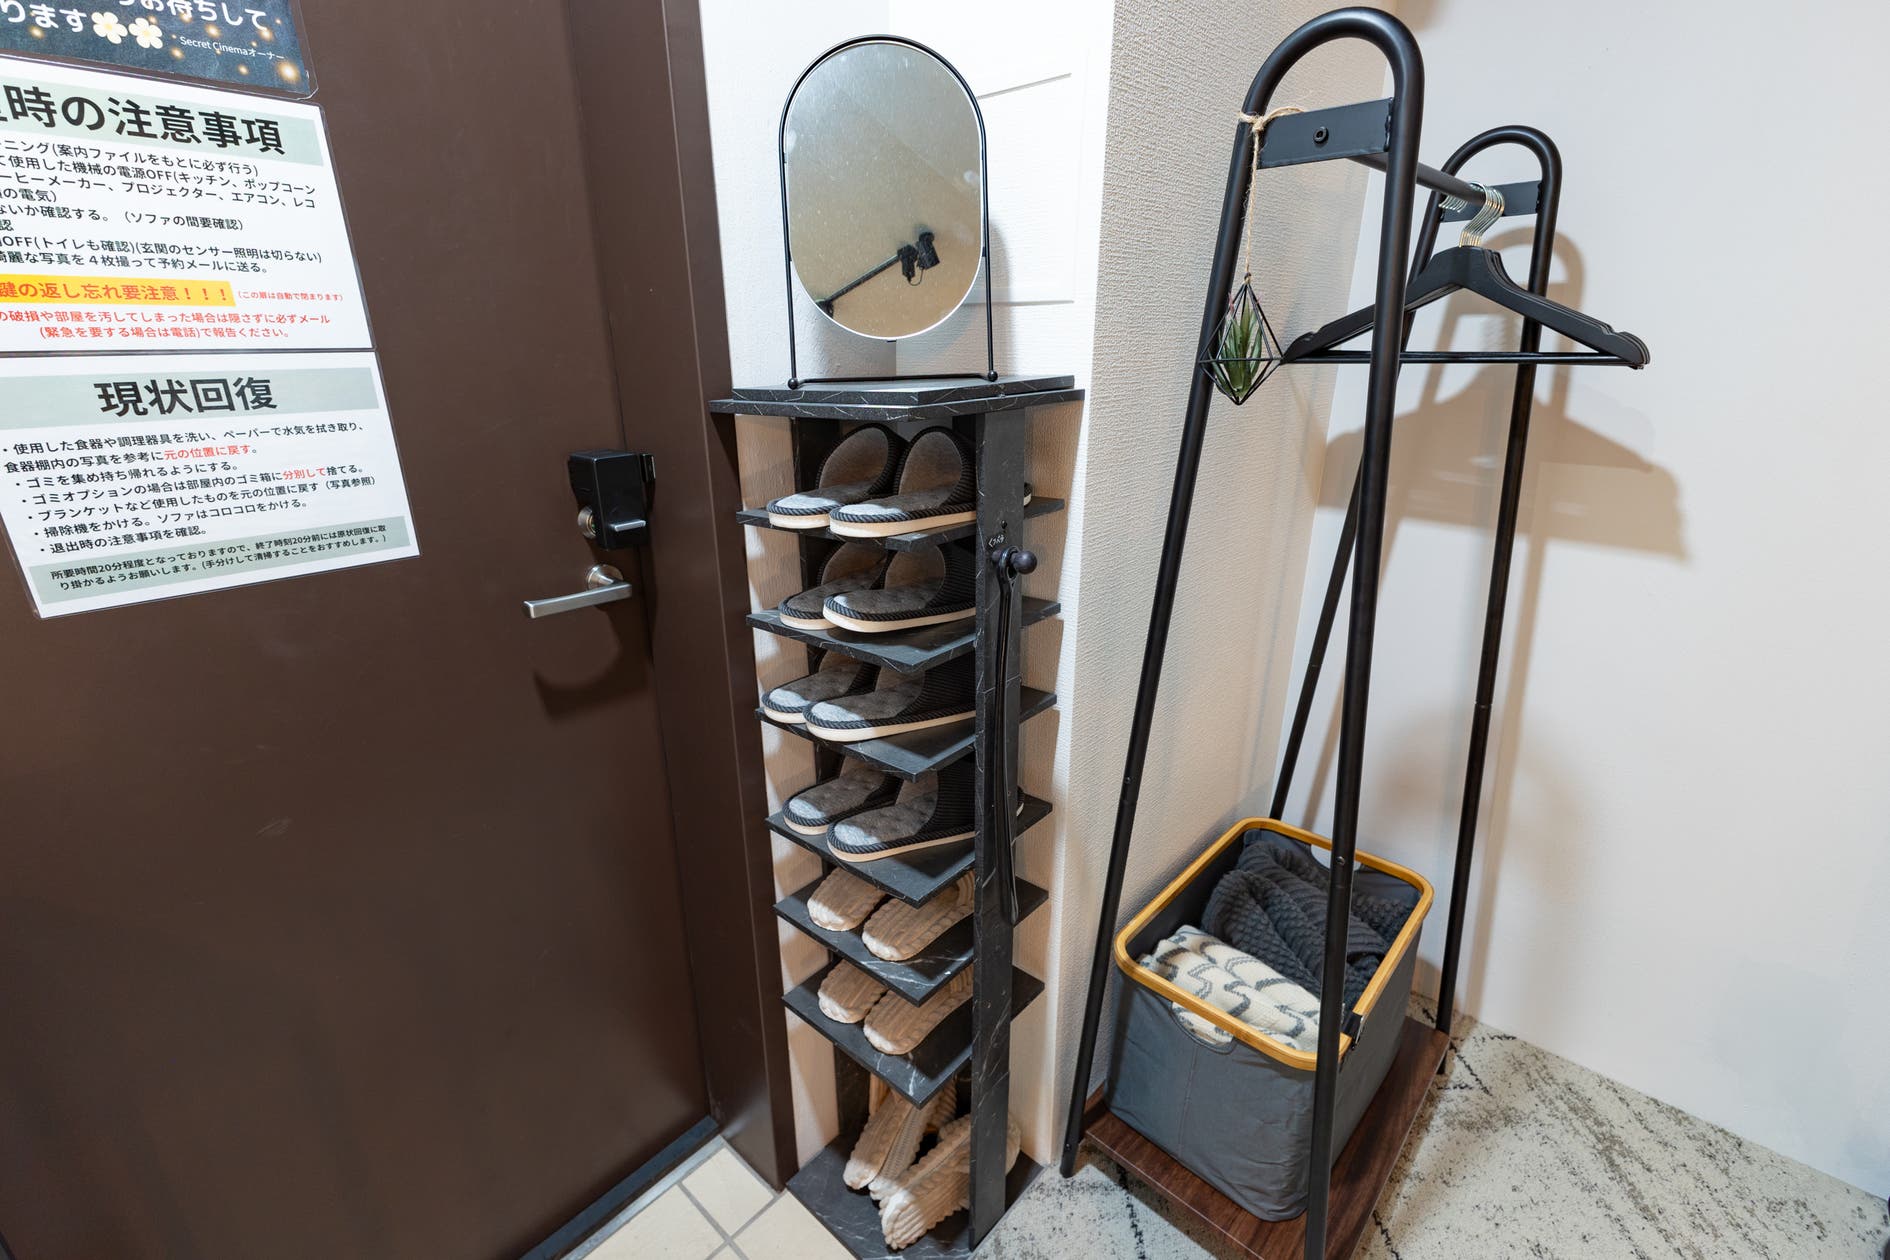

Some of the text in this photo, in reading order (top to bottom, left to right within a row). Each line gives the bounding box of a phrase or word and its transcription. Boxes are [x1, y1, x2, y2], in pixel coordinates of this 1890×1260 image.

[179, 36, 213, 50] Secret
[0, 85, 285, 155] 時の注意事項
[0, 140, 259, 177] ニング(案内ファイルをもとに必ず行う)
[0, 188, 56, 203] の電気)
[0, 236, 322, 263] OFF(トイレも確認)(玄関のセンサー照明は切らない)
[94, 378, 277, 417] 現状回復
